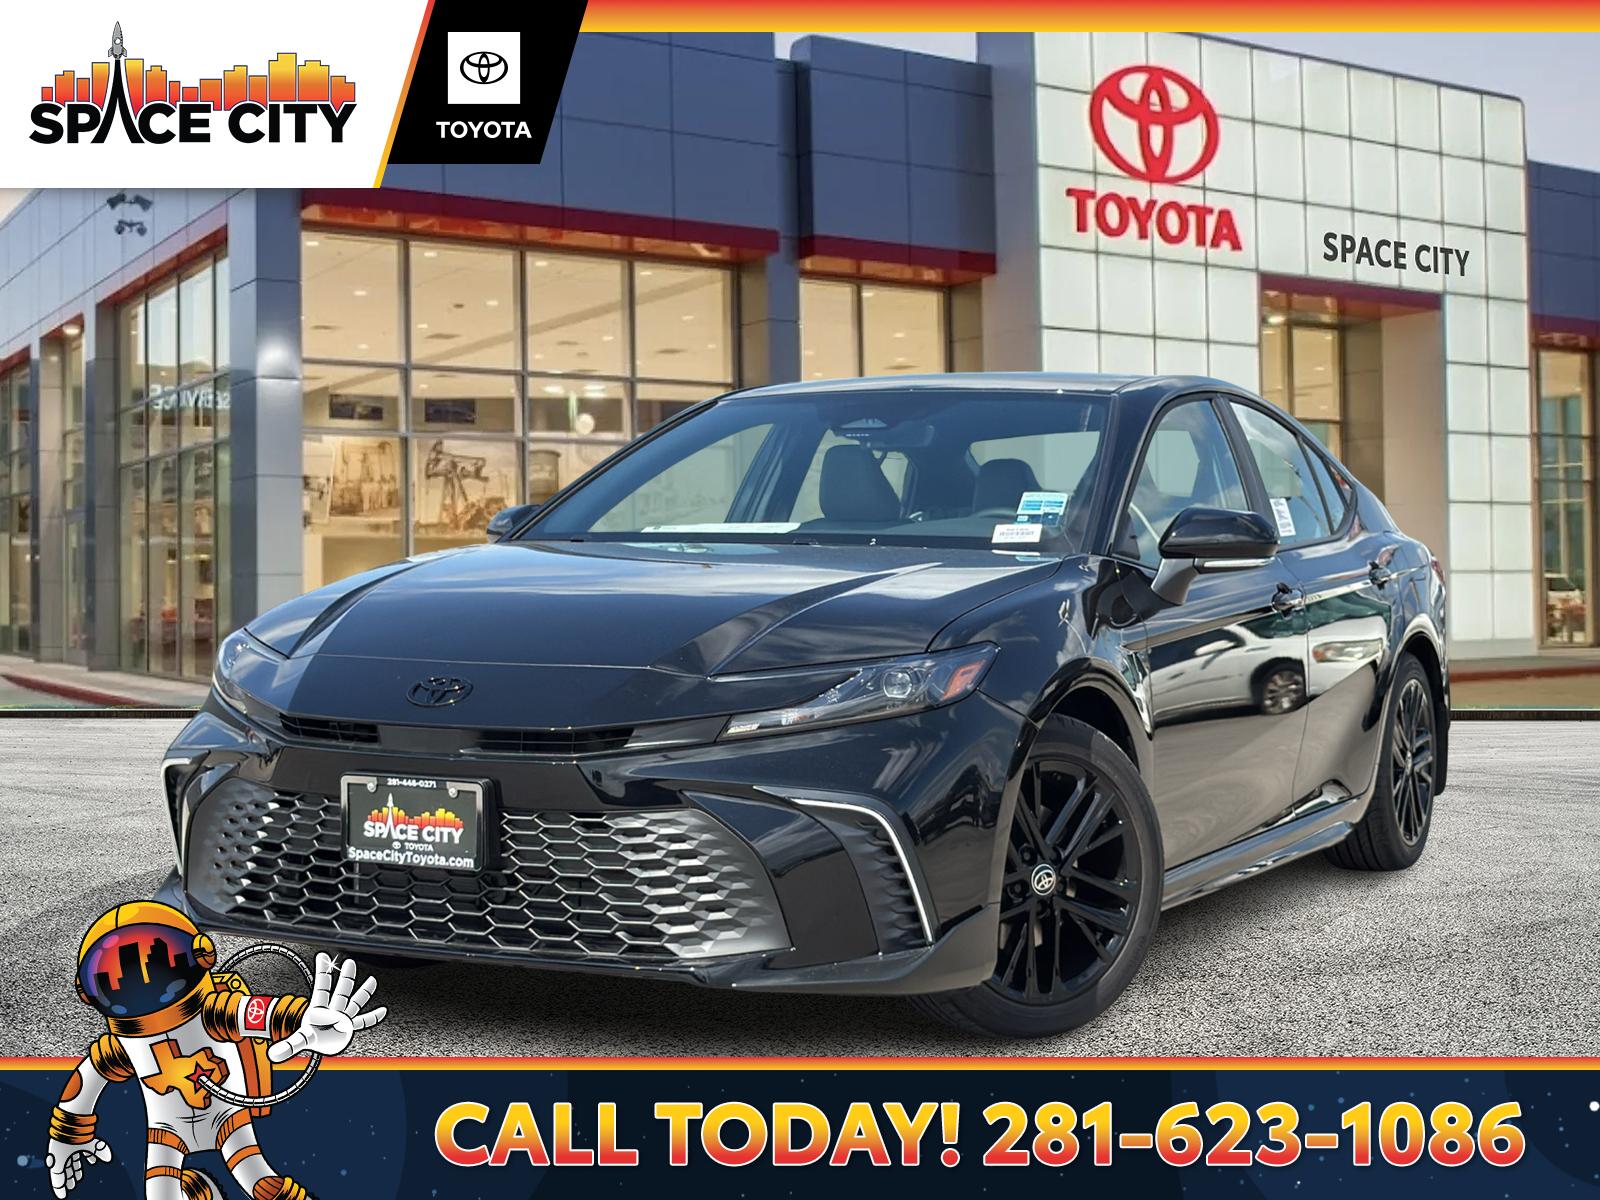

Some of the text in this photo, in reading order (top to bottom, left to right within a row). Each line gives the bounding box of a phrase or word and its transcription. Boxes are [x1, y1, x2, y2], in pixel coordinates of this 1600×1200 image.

[1065, 187, 1243, 251] TOYOTA
[1322, 231, 1471, 277] SPACE CITY
[362, 808, 464, 844] SPACE CITY
[347, 846, 475, 869] SpaceCityToyota.com
[404, 841, 434, 852] TOYOTA
